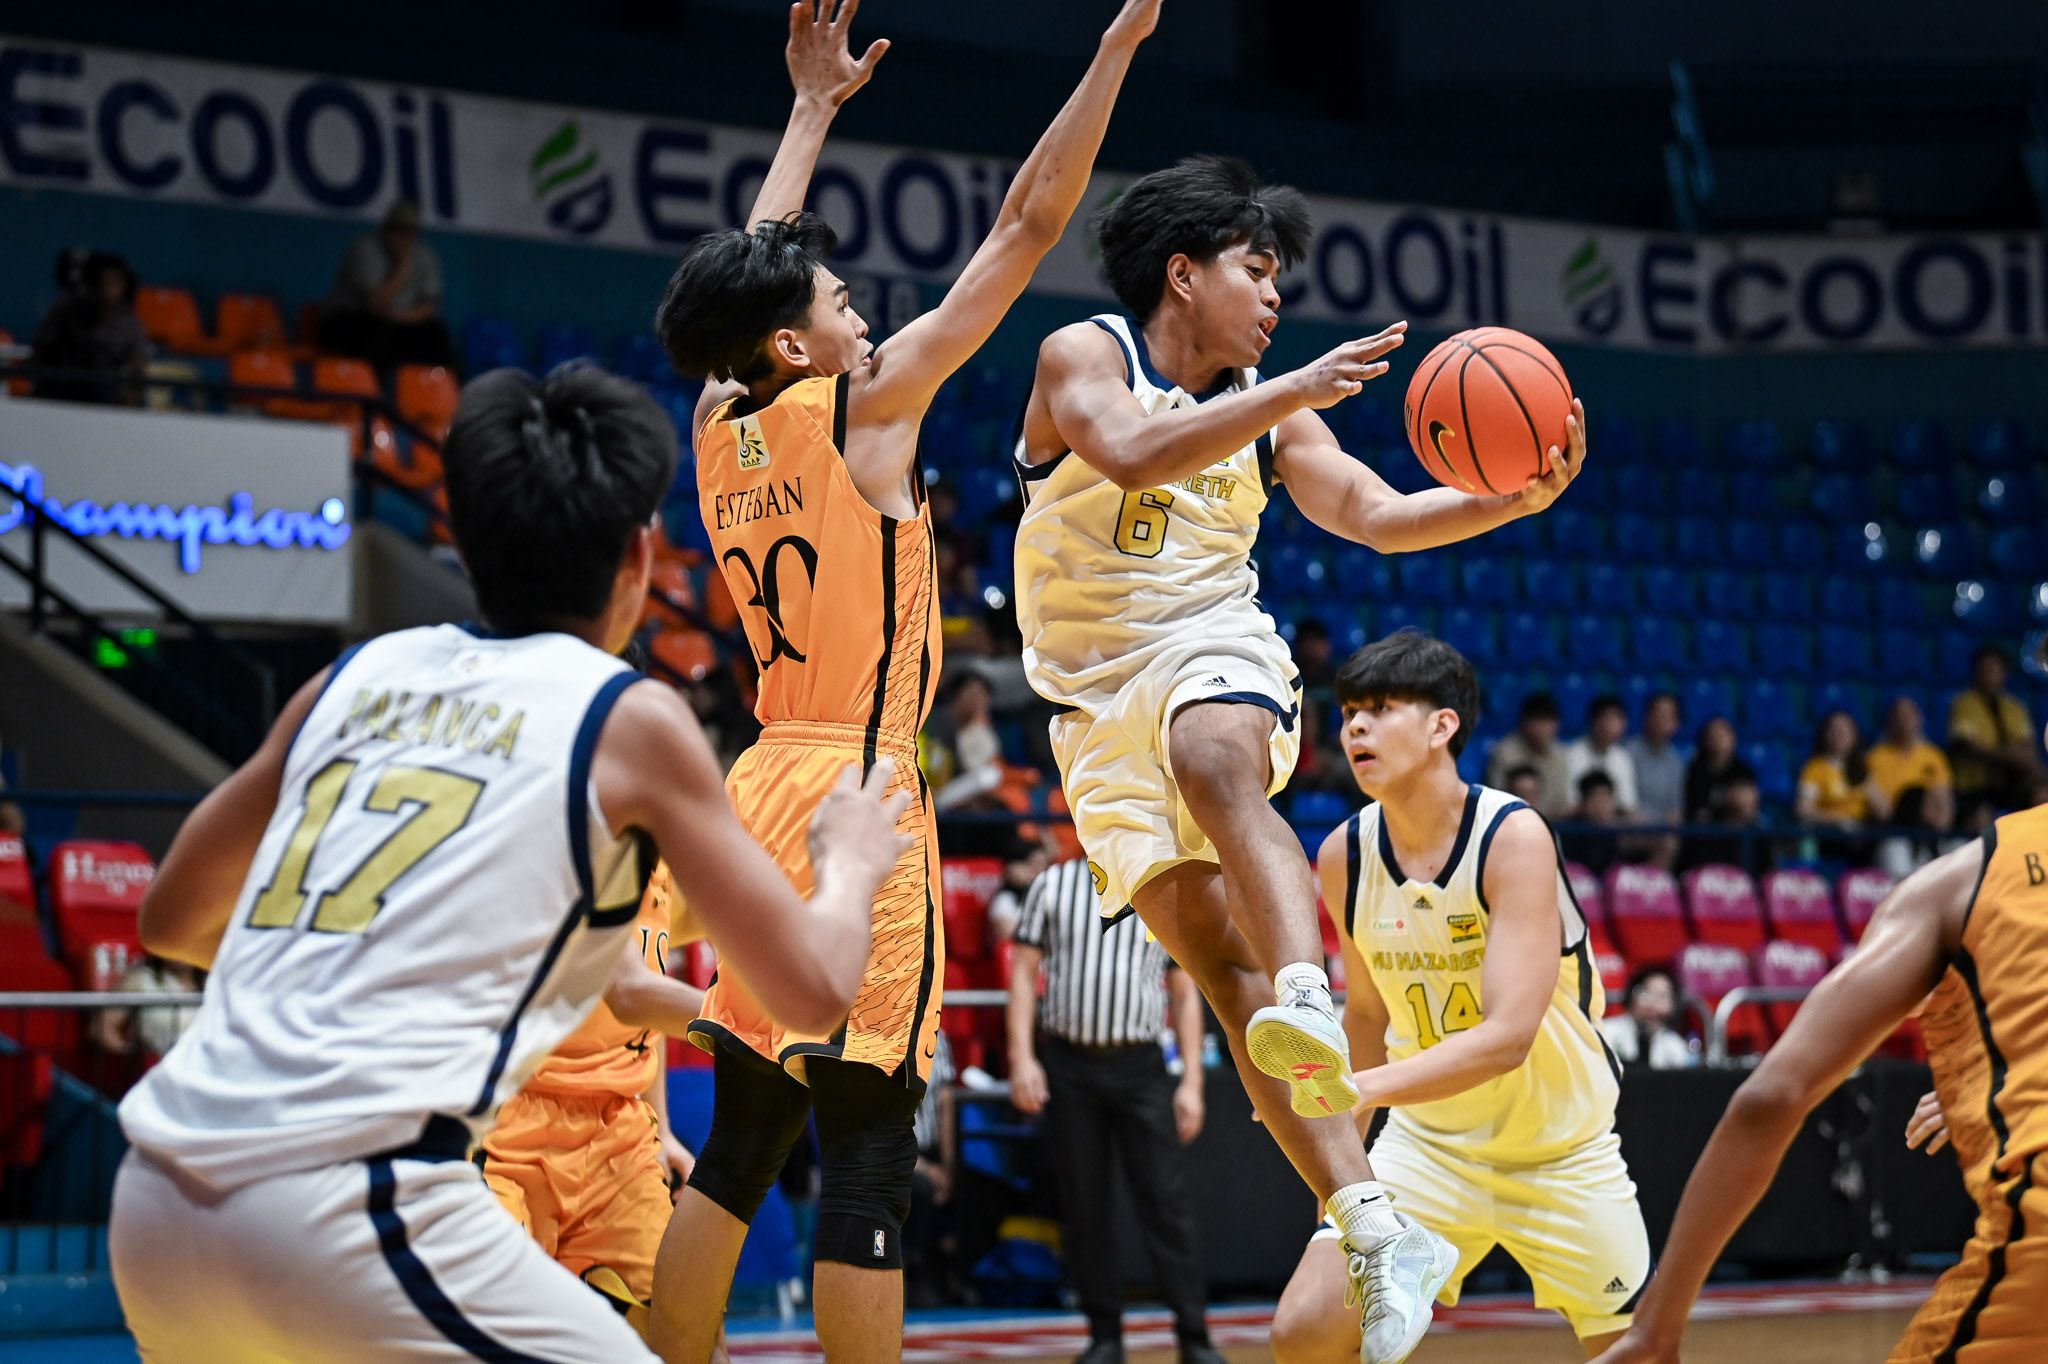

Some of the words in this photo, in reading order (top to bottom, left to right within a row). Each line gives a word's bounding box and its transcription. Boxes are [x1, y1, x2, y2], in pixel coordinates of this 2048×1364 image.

[0, 47, 457, 219] EcoOil
[636, 126, 1020, 270] EcoOi
[716, 477, 804, 530] ESTEBAN
[1114, 488, 1175, 558] 6
[722, 534, 819, 671] 30
[246, 757, 487, 939] 17
[1405, 982, 1483, 1049] 14
